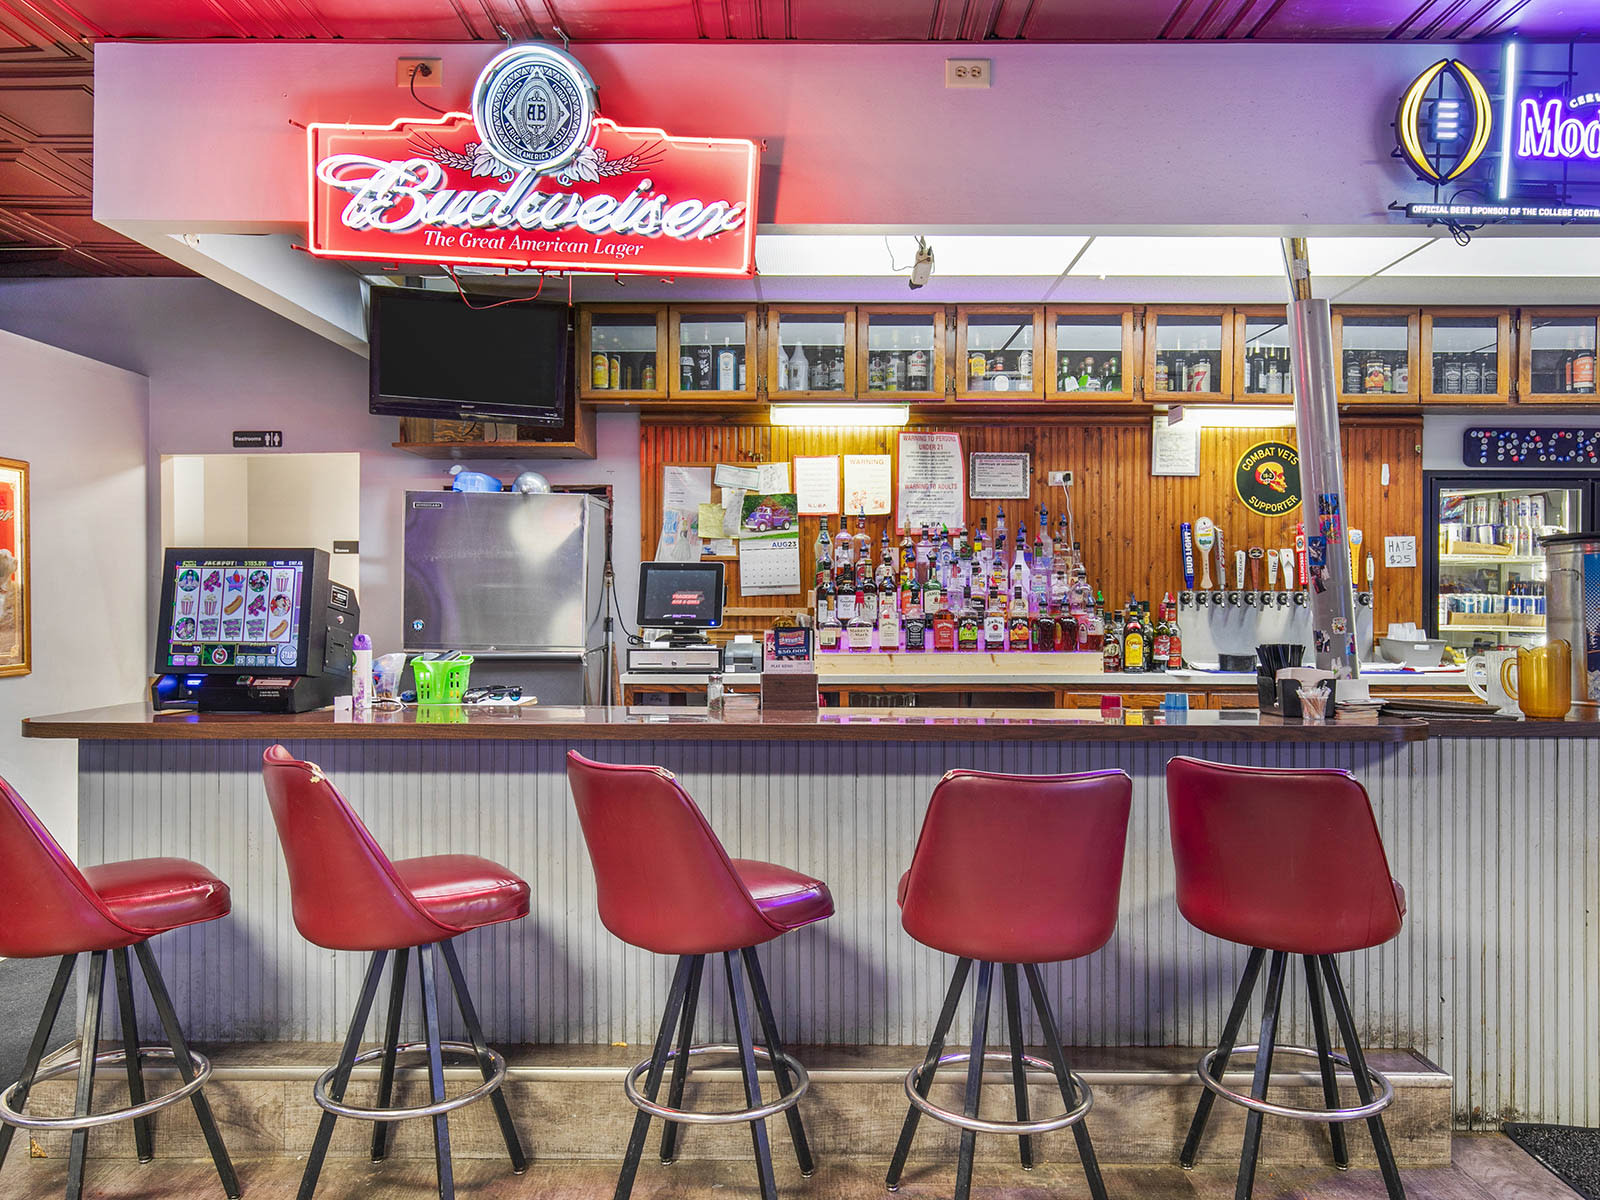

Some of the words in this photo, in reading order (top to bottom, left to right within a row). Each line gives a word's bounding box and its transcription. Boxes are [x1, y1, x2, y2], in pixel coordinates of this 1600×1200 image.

[527, 103, 547, 121] AB
[504, 121, 521, 144] AFRICA
[552, 127, 568, 144] ASIA
[521, 151, 550, 161] AMERICA
[316, 153, 745, 241] Budweiser
[1412, 205, 1448, 214] OFFICIAL
[1450, 205, 1470, 214] BEER
[1472, 206, 1508, 215] SPONSOR
[1510, 206, 1521, 215] OF
[1522, 207, 1537, 216] THE
[1538, 207, 1573, 217] COLLEGE
[424, 230, 456, 247] The
[459, 232, 505, 250] Great
[508, 236, 591, 254] American
[593, 238, 644, 260] Lager
[1194, 371, 1207, 392] 7
[1242, 447, 1276, 472] COMBAT
[1277, 447, 1299, 465] VETS
[1248, 494, 1299, 512] SUPPORTER
[1184, 531, 1193, 556] LIGHT
[1388, 540, 1414, 552] HATS
[1186, 556, 1194, 574] BUD
[1390, 554, 1412, 565] $25
[193, 645, 201, 653] 10
